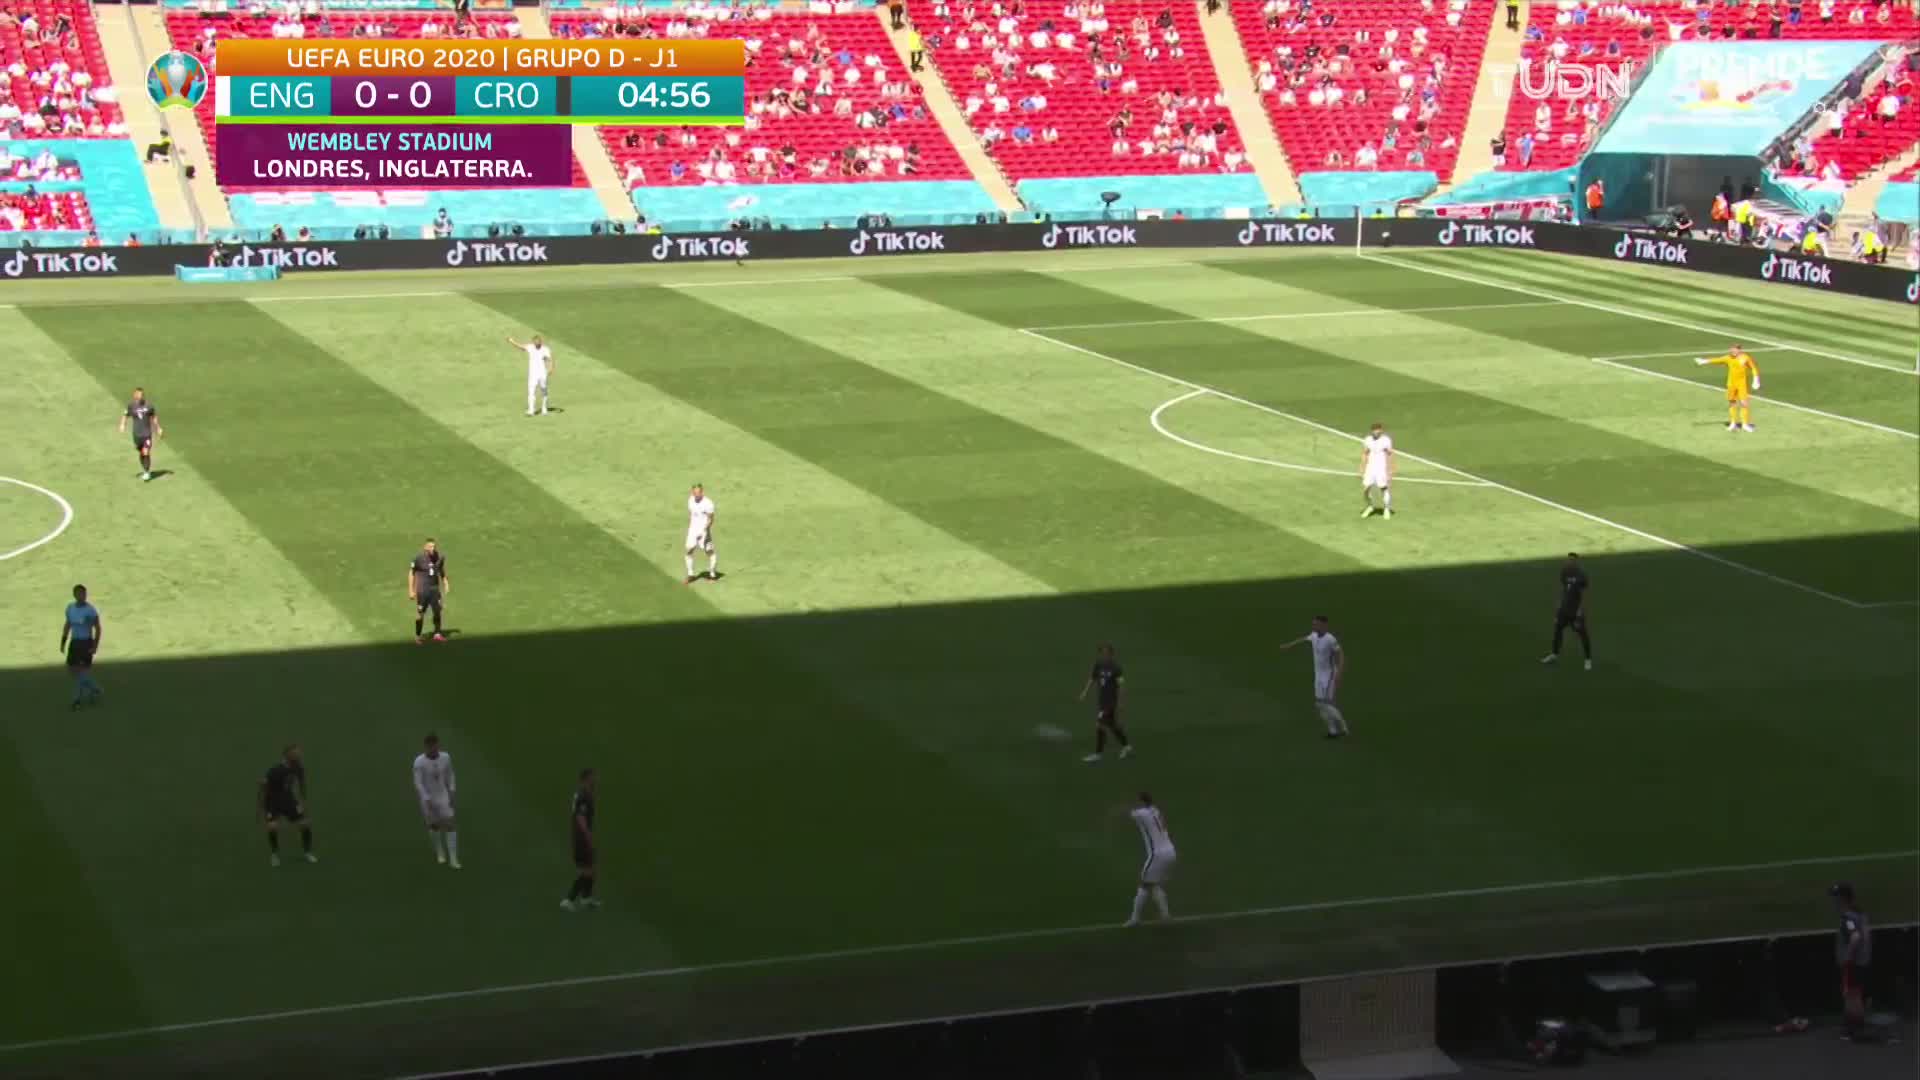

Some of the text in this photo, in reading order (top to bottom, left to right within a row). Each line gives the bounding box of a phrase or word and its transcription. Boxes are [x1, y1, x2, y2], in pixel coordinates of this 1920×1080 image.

[873, 231, 945, 252] TikTok
[1065, 225, 1137, 246] TikTok
[1261, 222, 1336, 244] TikTok
[1462, 223, 1535, 246] TikTok
[260, 246, 338, 268] TikTok
[471, 241, 549, 263] TikTok
[675, 236, 750, 258] TikTok
[1632, 237, 1688, 264] TikTok
[32, 252, 118, 273] TikTok
[1778, 258, 1832, 286] TikTok
